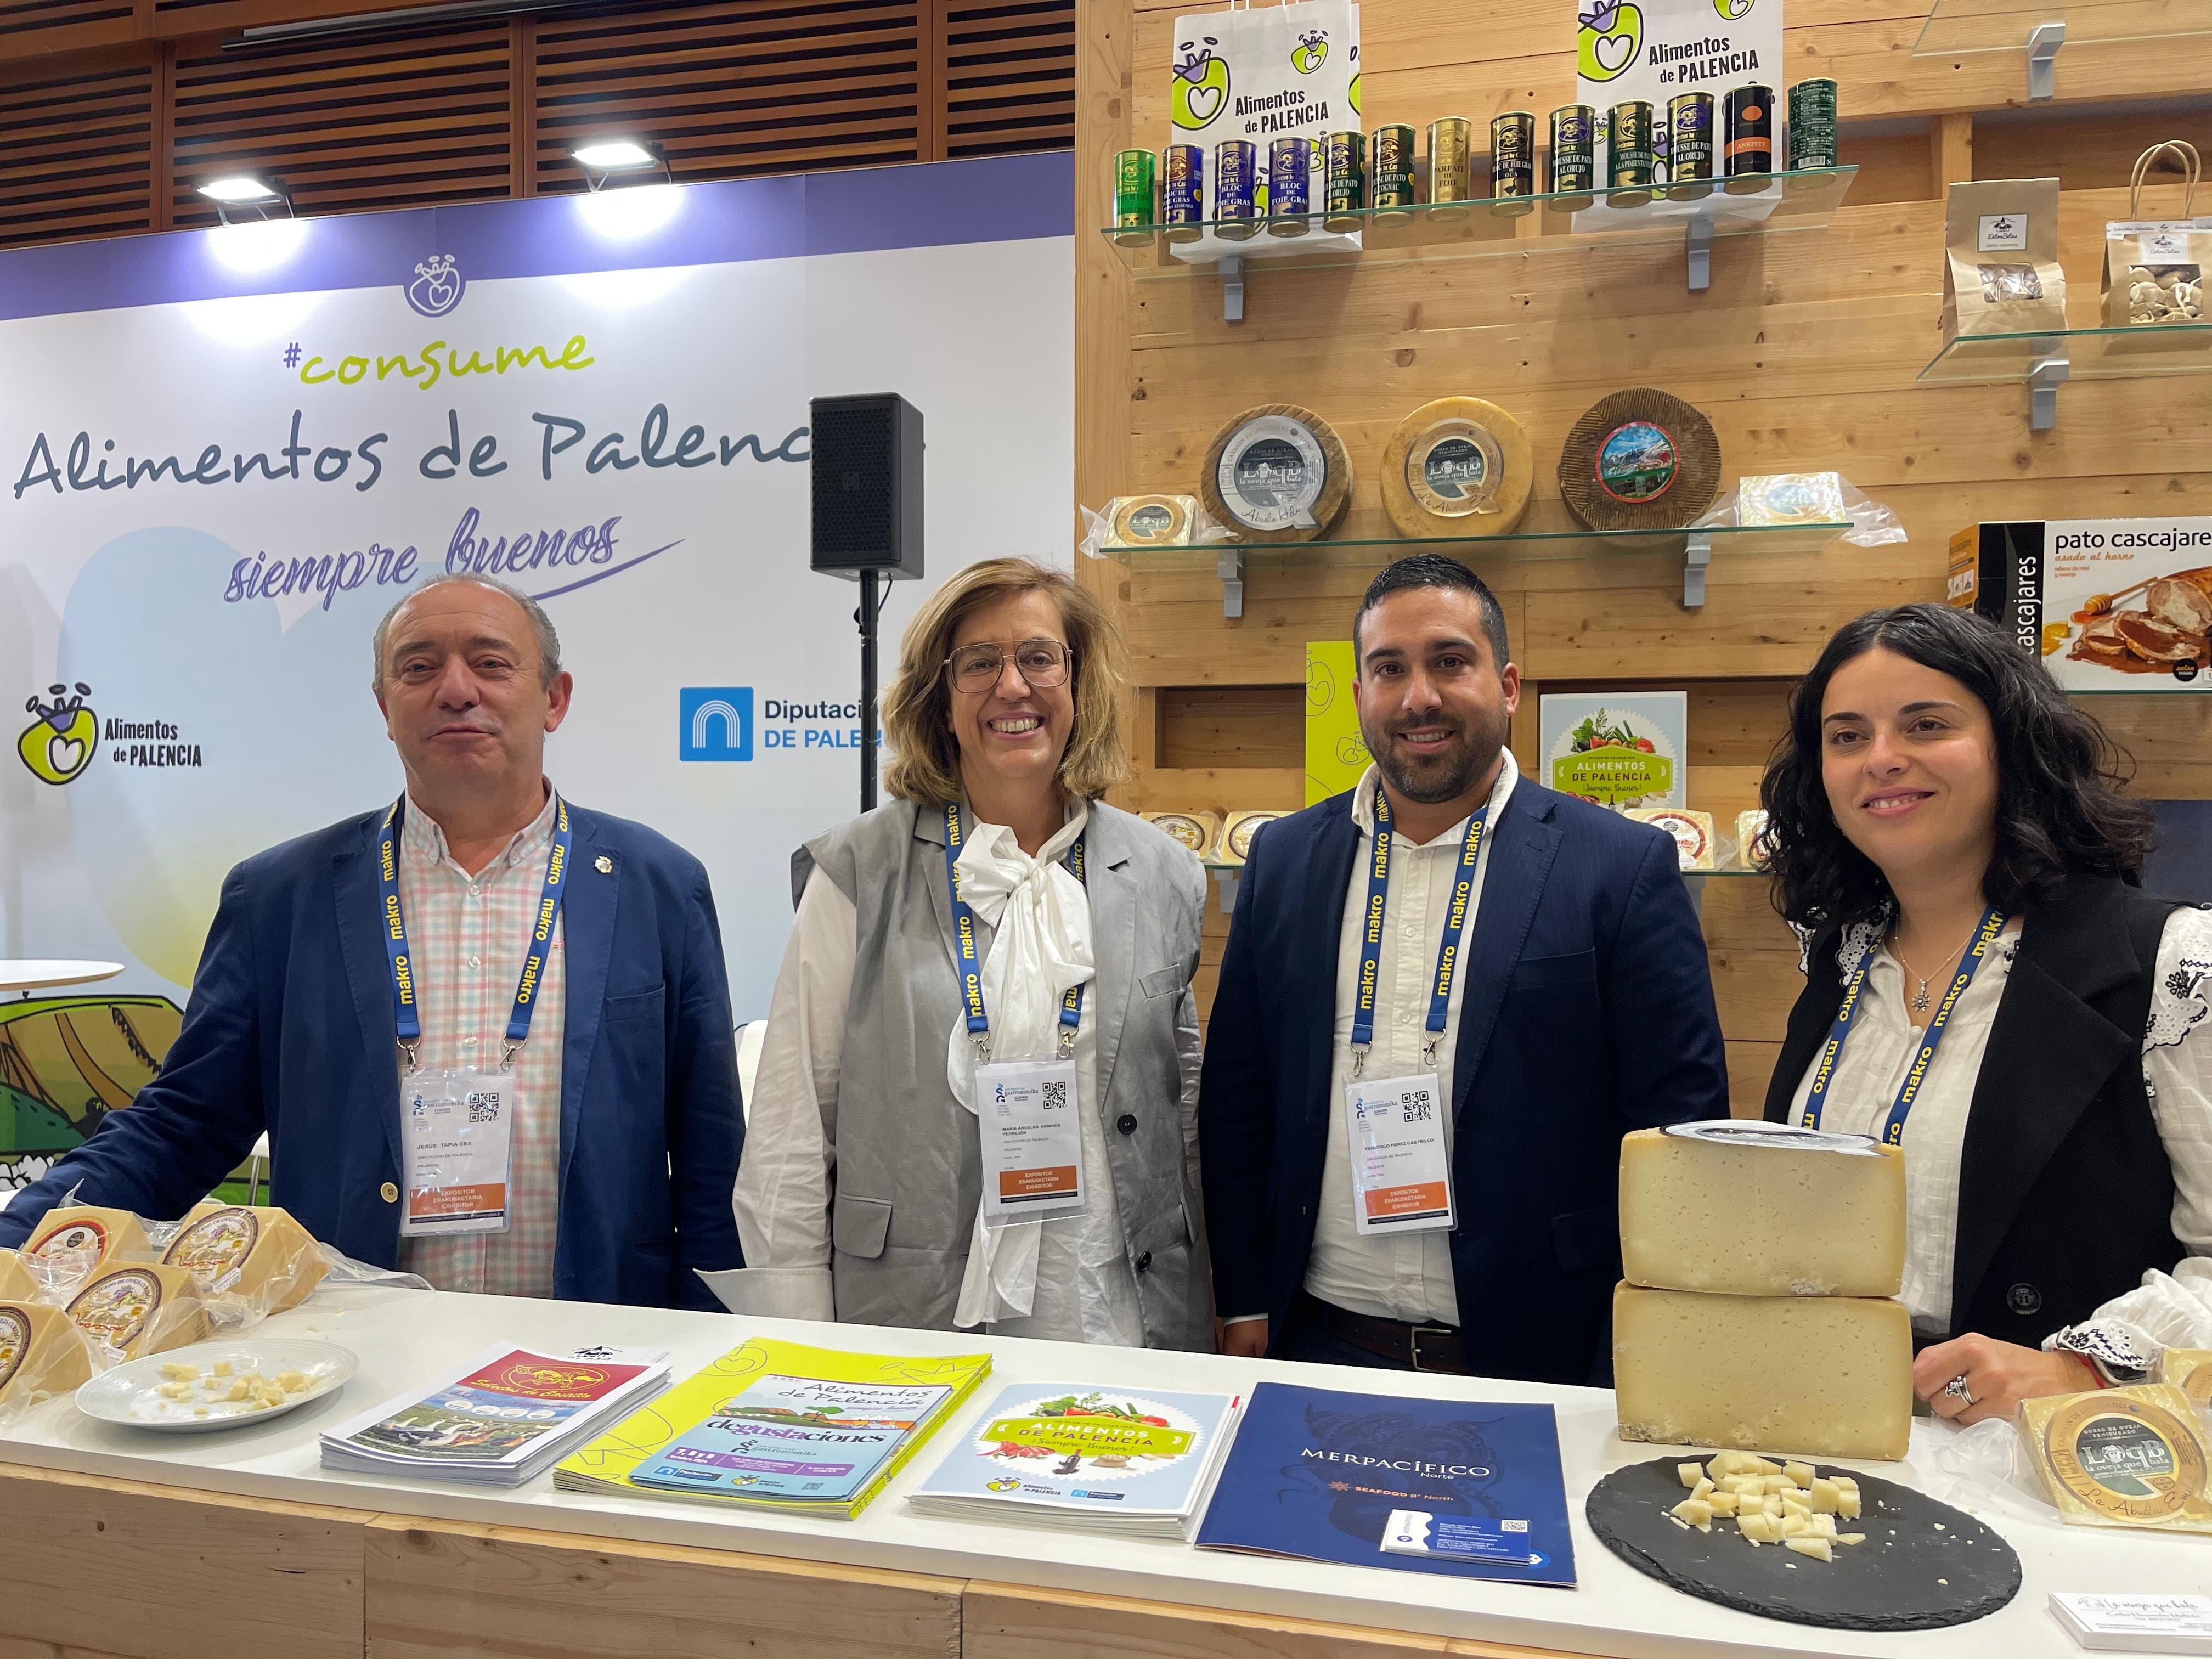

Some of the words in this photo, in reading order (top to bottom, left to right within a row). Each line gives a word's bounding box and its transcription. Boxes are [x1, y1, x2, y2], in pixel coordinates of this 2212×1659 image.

[1649, 37, 1730, 66] Alimentos
[1660, 69, 1674, 83] de
[1679, 50, 1759, 83] PALENCIA
[1235, 89, 1305, 116] Alimentos
[1245, 120, 1259, 133] de
[1261, 101, 1329, 134] PALENCIA
[1671, 143, 1691, 154] MUSSE
[1685, 151, 1705, 160] ORUJO
[1559, 166, 1567, 174] AL
[1567, 164, 1585, 173] ORUJO
[1215, 199, 1229, 209] FOIE
[1272, 196, 1289, 205] FOIE
[1290, 196, 1308, 205] GRAS
[1333, 188, 1350, 197] ORUJO
[284, 334, 595, 391] #consume
[14, 410, 388, 499] Alimentos
[419, 409, 508, 479] de
[532, 403, 810, 481] Palenc
[1417, 493, 1431, 505] La
[2056, 531, 2104, 554] pato
[2111, 528, 2212, 552] cascajare
[224, 543, 419, 612] siempre
[445, 506, 622, 577] buenos
[2055, 552, 2085, 561] asado
[2090, 552, 2101, 560] al
[2105, 551, 2134, 560] horno
[765, 699, 861, 723] Diputaci
[105, 718, 178, 740] Alimentos
[765, 730, 796, 747] DE
[805, 730, 861, 747] PALE
[114, 747, 126, 762] de
[130, 744, 202, 766] PALENCIA
[1577, 761, 1646, 770] ALIMENTOS
[1572, 773, 1587, 781] DE
[1592, 772, 1651, 781] PALENCIA
[1378, 790, 1390, 822] makro
[950, 805, 960, 846] makro
[1375, 832, 1389, 878] makro
[1463, 821, 1482, 866] makro
[381, 840, 395, 882] makro
[548, 844, 565, 885] makro
[386, 895, 403, 940] makro
[1368, 894, 1384, 943] makro
[1449, 881, 1469, 929] makro
[535, 898, 555, 941] makro
[960, 916, 974, 959] makro
[1972, 912, 2004, 957] makr
[396, 955, 413, 1005] makro
[517, 955, 540, 1004] makro
[1361, 960, 1375, 1009] makro
[1437, 945, 1455, 996] makro
[967, 974, 983, 1016] makro
[1839, 970, 1864, 1022] makro
[1934, 974, 1968, 1026] makro
[1813, 1040, 1838, 1093] makro
[1902, 1046, 1932, 1103] makro
[433, 1195, 483, 1203] ERAKUSKETARIA
[470, 1379, 520, 1392] Selectos
[778, 1389, 806, 1398] de
[812, 1392, 925, 1406] Palencia
[805, 1384, 933, 1398] Alimentos
[707, 1419, 887, 1443] degustaciones
[1031, 1423, 1149, 1437] ALIMENTOS
[1053, 1431, 1153, 1446] PALENCIA
[2092, 1429, 2136, 1438] SEMICURADO
[751, 1447, 817, 1457] gastronomika
[1301, 1448, 1490, 1477] MERPACÍFICO
[2096, 1463, 2121, 1471] oveja
[2124, 1462, 2142, 1472] que
[1355, 1486, 1408, 1497] SEAFOOD
[2078, 1488, 2105, 1506] La
[2108, 1500, 2163, 1516] Abuela
